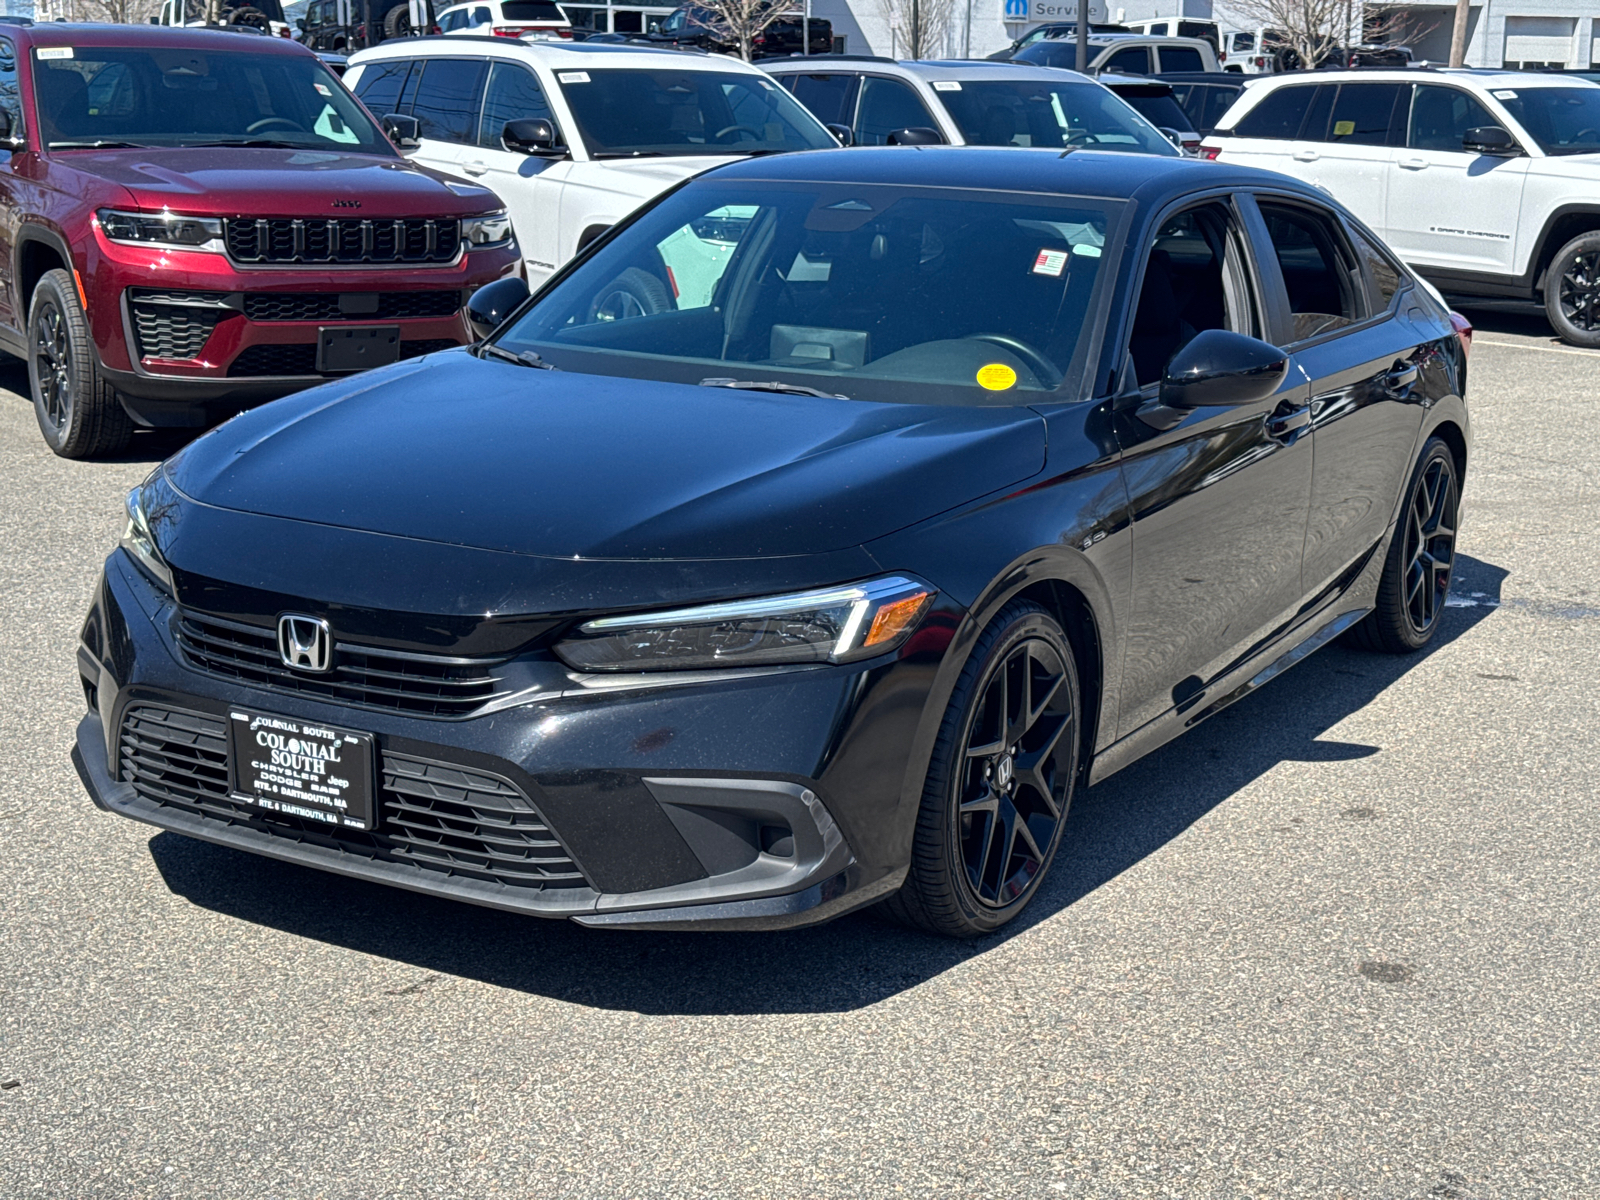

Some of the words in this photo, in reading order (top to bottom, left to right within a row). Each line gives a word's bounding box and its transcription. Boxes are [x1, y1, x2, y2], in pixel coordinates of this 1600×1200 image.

[1036, 3, 1097, 16] Servie
[256, 716, 299, 733] COLONIAL
[303, 726, 335, 740] SOUTH
[256, 730, 341, 763] COLONIAL
[251, 760, 319, 782] CHRYSLER
[271, 749, 326, 775] SOUTH
[260, 771, 302, 789] DODGE
[327, 775, 349, 789] Jeep
[333, 797, 348, 809] MA
[326, 813, 338, 824] MA
